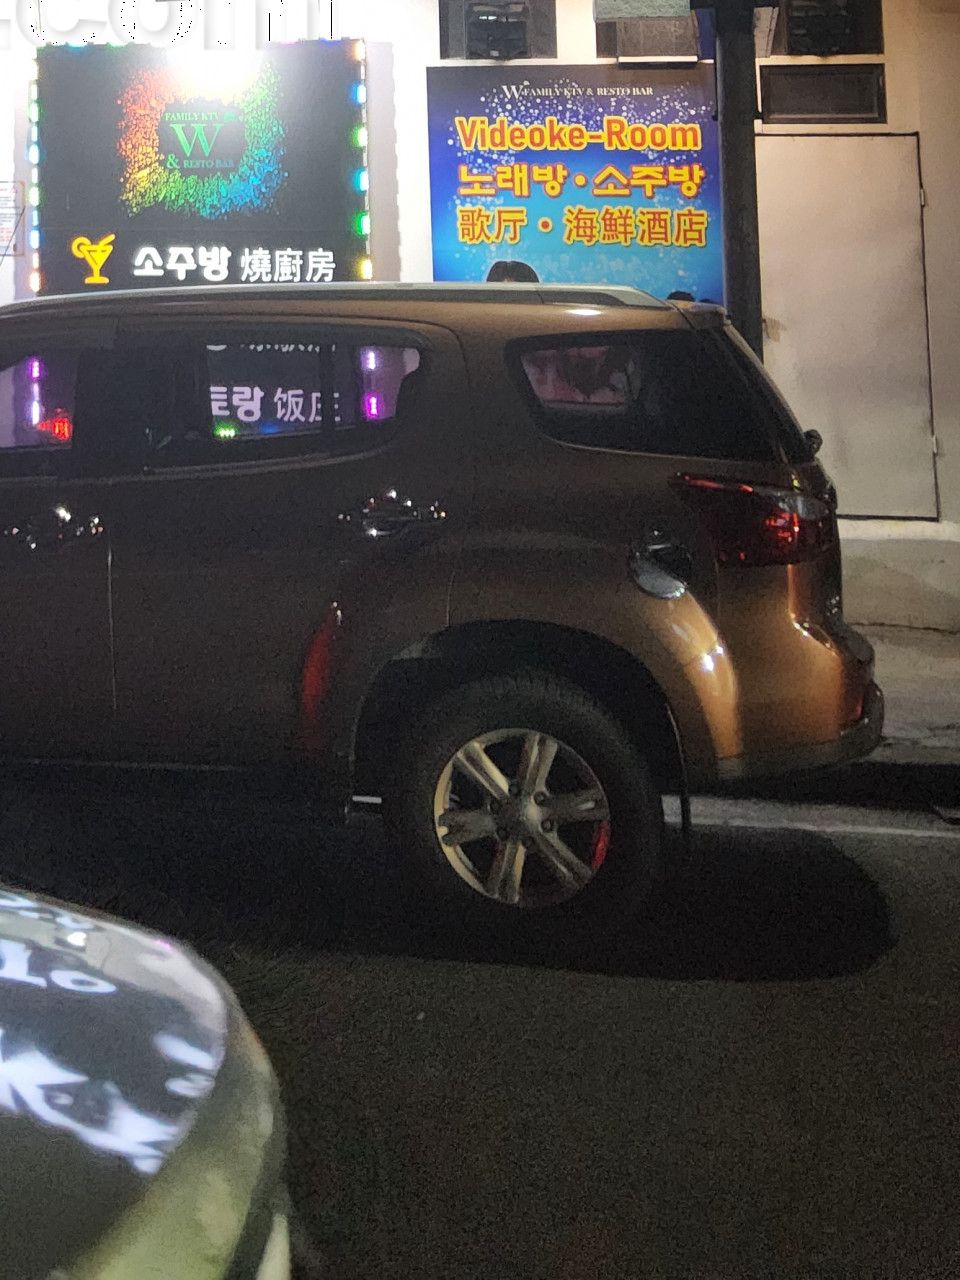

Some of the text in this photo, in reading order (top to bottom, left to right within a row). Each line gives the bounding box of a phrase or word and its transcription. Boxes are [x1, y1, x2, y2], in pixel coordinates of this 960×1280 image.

[524, 87, 561, 96] FAMILY
[597, 87, 630, 96] RESTO
[632, 87, 653, 96] BAR
[169, 123, 223, 157] W
[455, 116, 702, 150] Videoke-Room
[166, 153, 180, 168] &
[133, 246, 232, 281] 소주방
